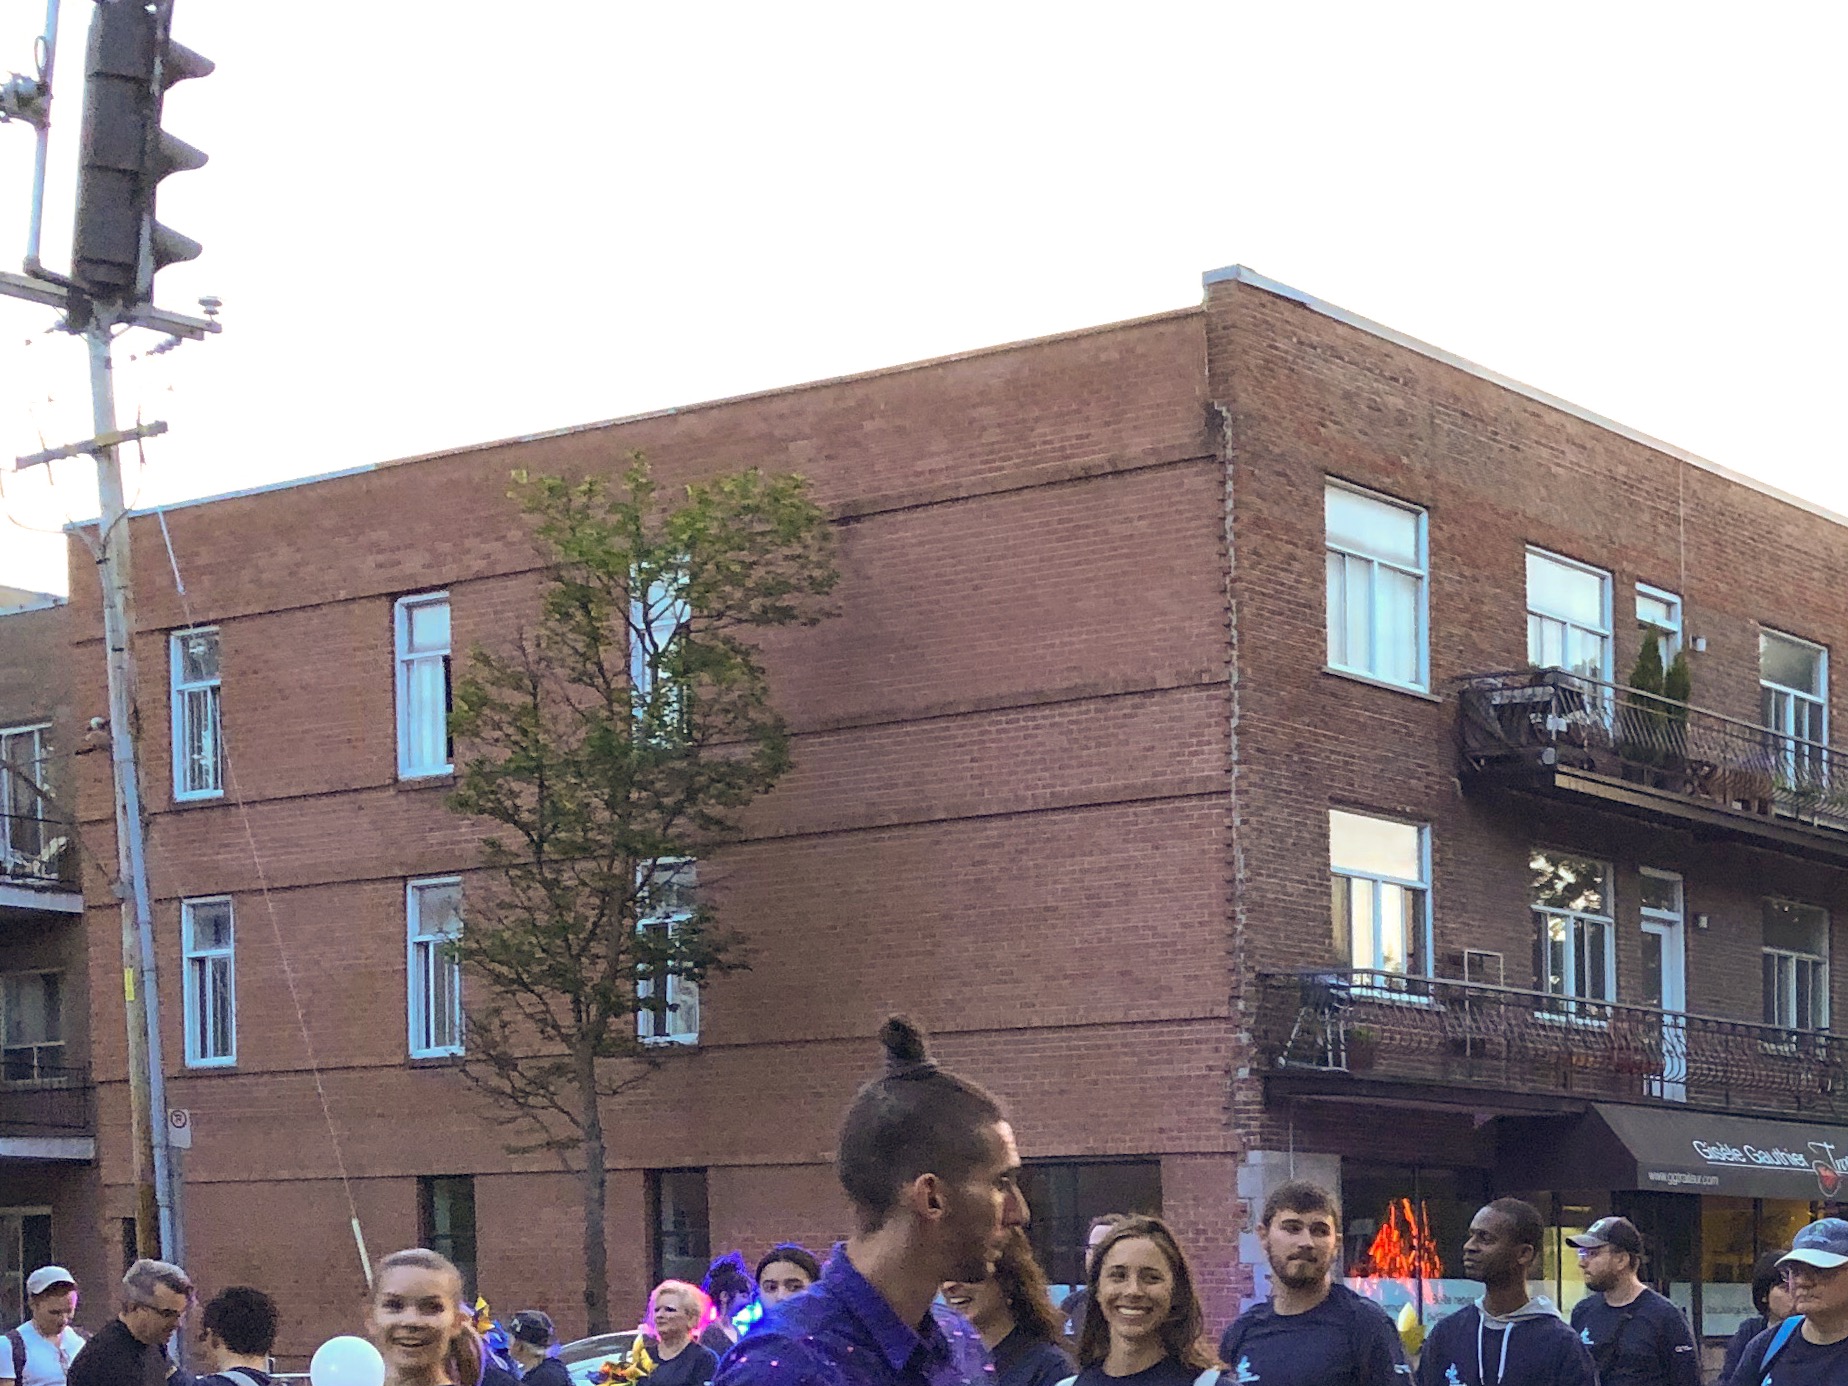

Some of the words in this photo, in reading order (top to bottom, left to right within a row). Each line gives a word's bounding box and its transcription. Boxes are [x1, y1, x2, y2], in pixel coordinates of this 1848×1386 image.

[1692, 1140, 1747, 1163] Gisèle
[1743, 1144, 1811, 1168] Gauthier
[1648, 1171, 1719, 1185] www.ggtraiteur.com
